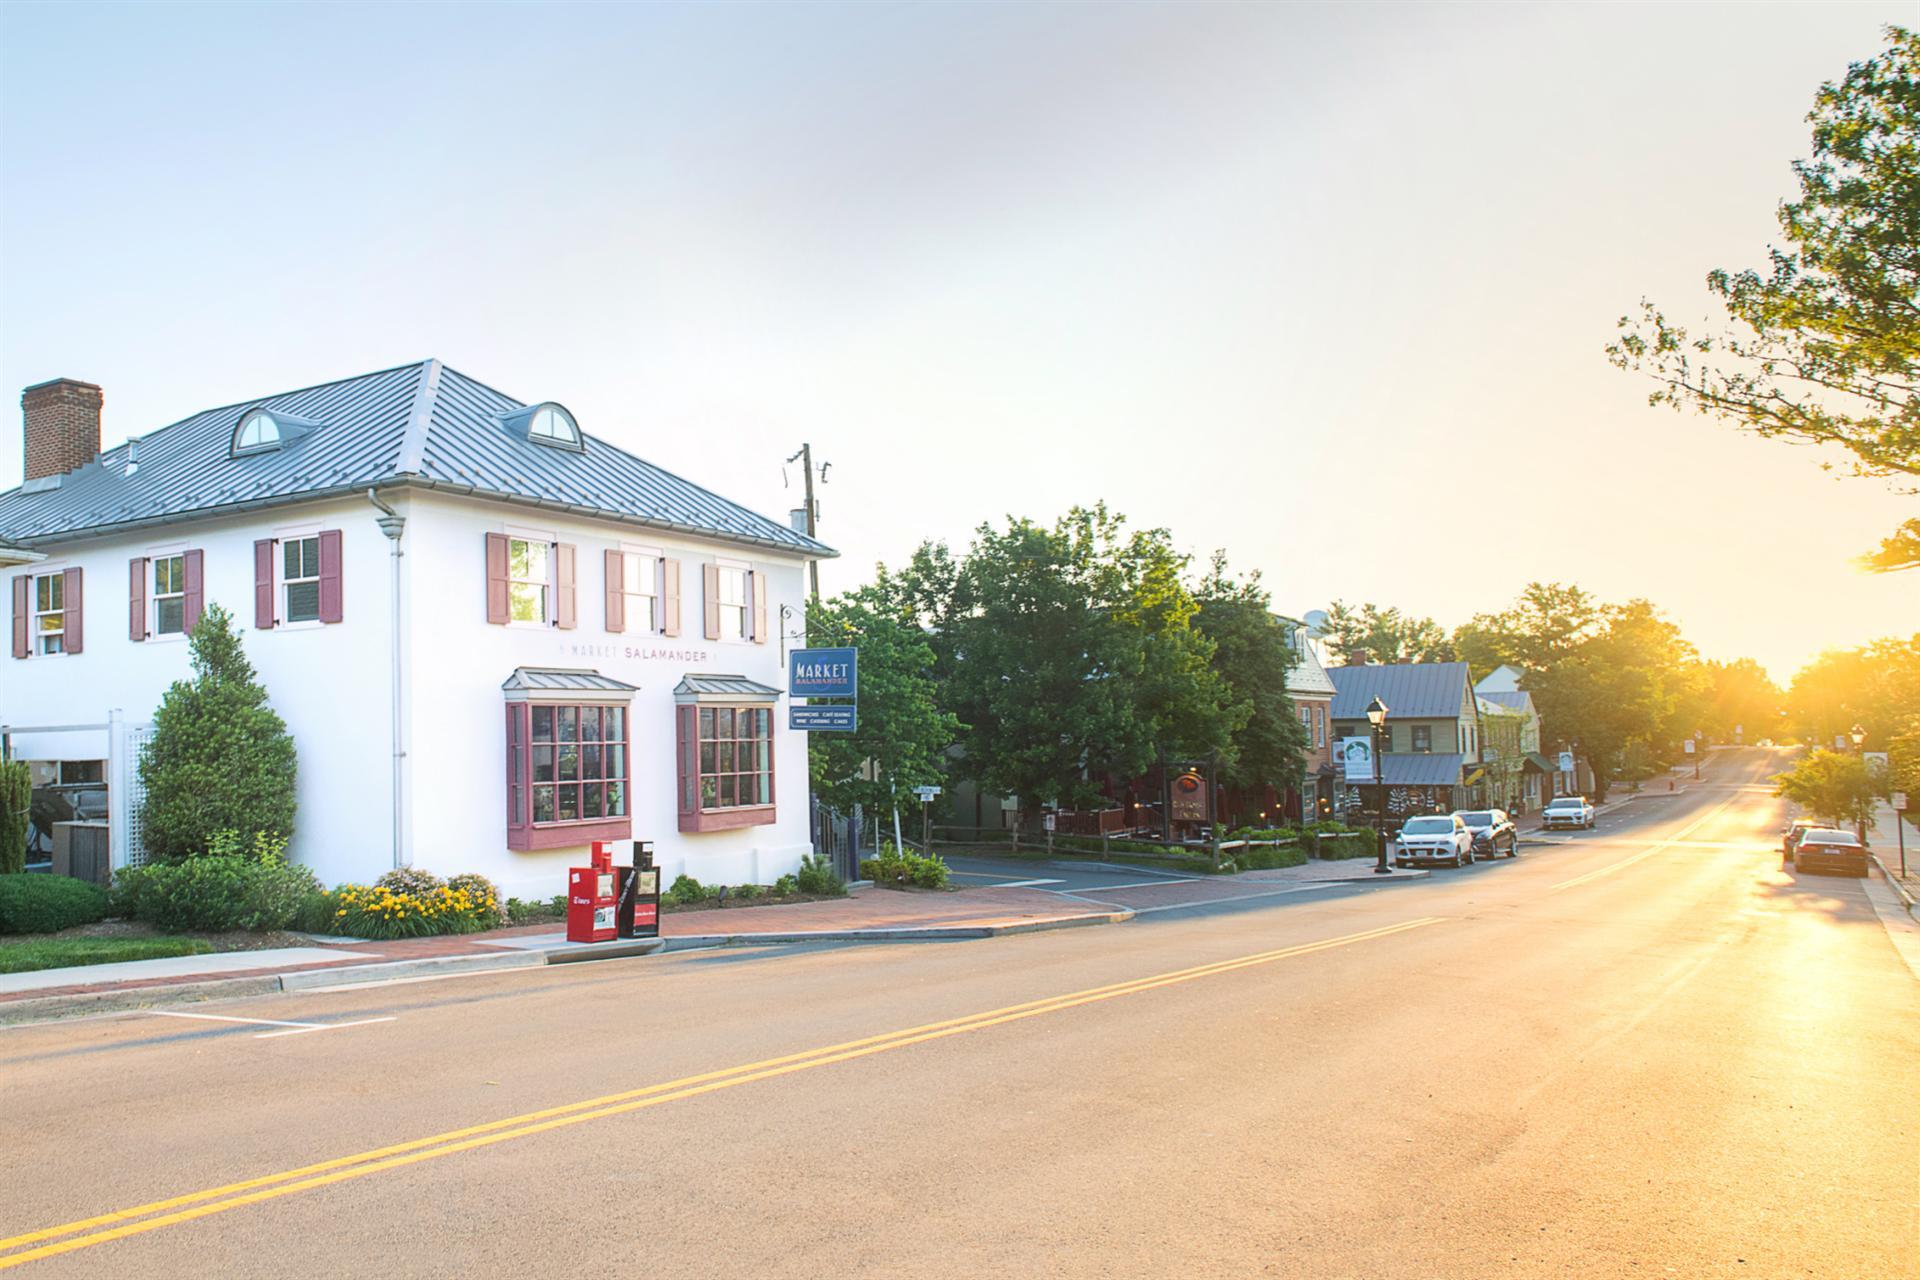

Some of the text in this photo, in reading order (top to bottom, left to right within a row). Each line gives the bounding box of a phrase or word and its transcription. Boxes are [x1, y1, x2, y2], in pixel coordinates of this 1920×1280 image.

[572, 646, 707, 662] MARKET SALAMANDER
[796, 662, 848, 678] MARKET
